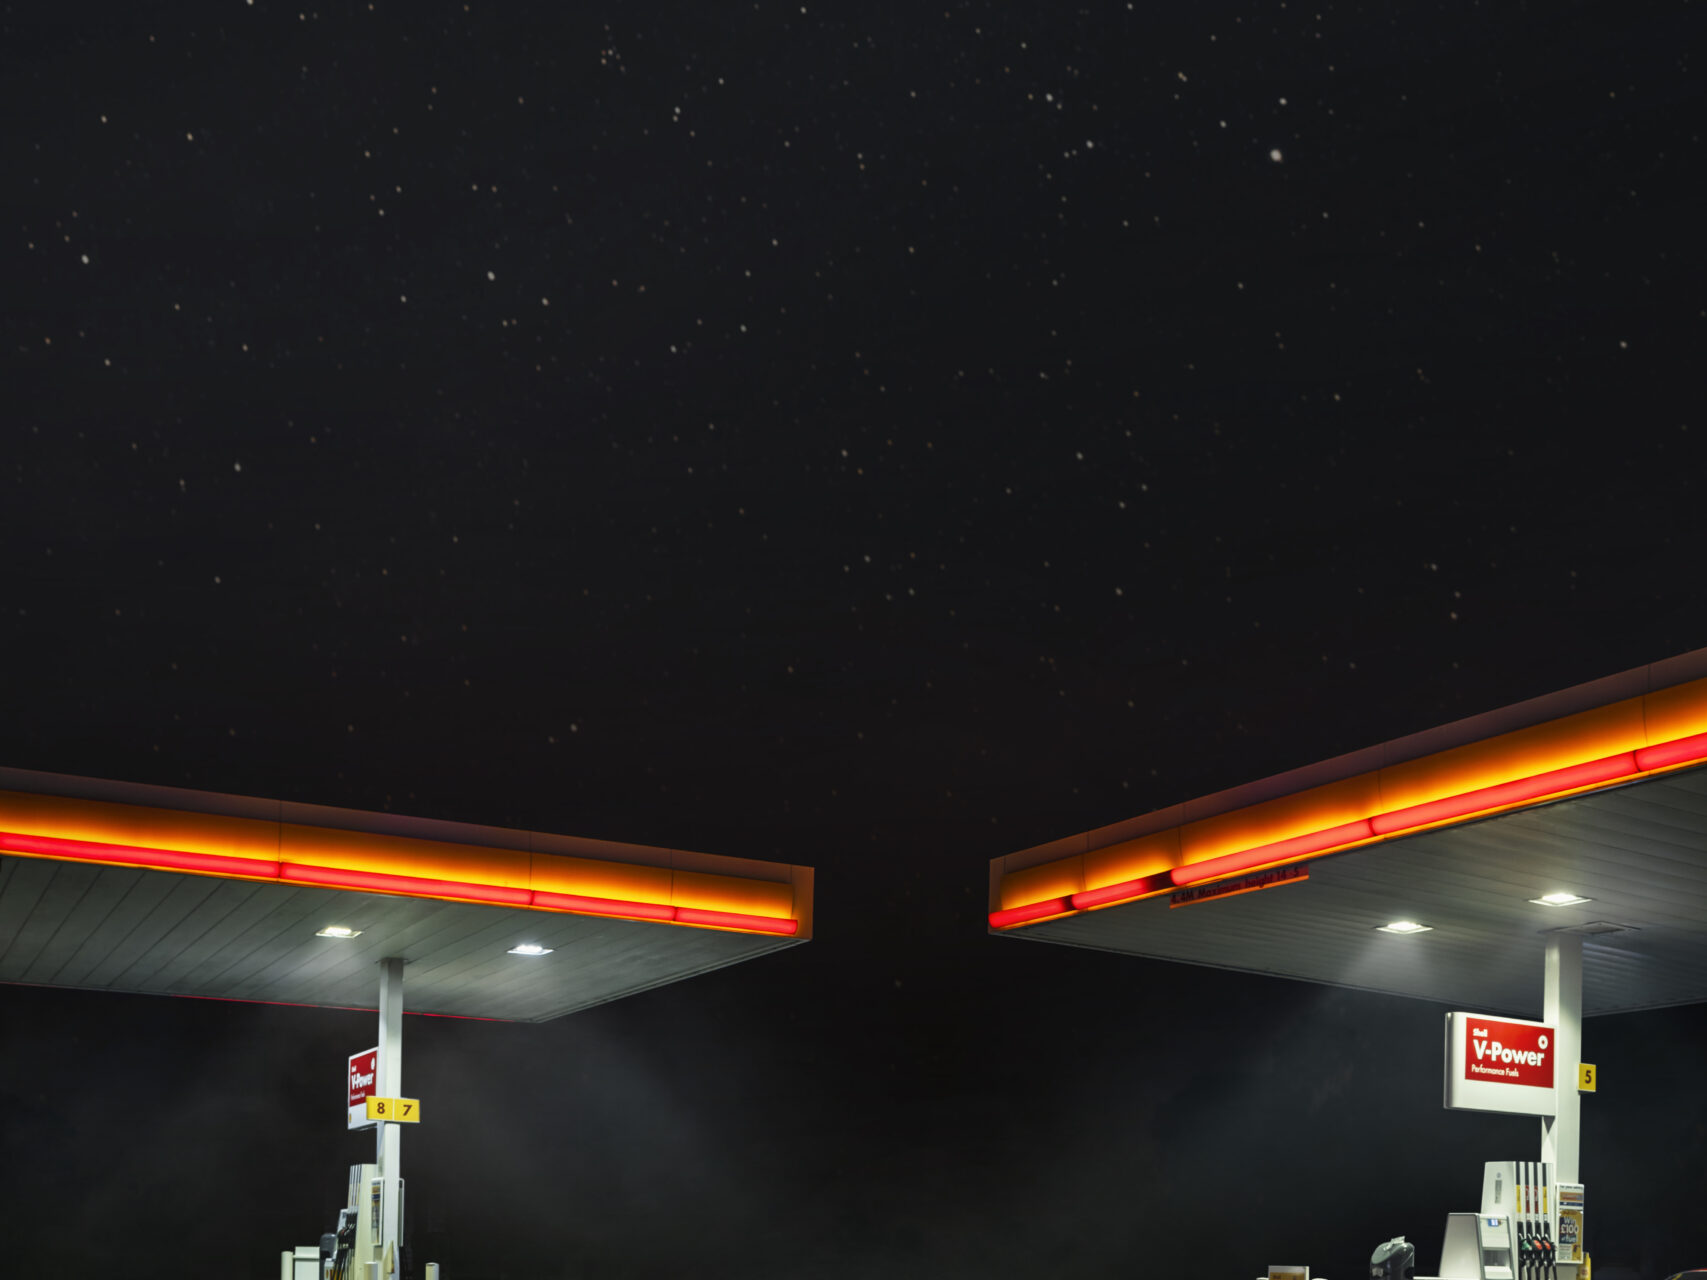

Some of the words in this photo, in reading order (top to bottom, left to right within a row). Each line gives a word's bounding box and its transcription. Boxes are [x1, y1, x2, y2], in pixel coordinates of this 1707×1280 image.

[1473, 1039, 1545, 1066] V-Power
[1471, 1064, 1505, 1076] Performance
[1505, 1067, 1519, 1077] Fuels
[1585, 1070, 1591, 1083] 5
[377, 1102, 385, 1114] 8
[403, 1104, 412, 1116] 7
